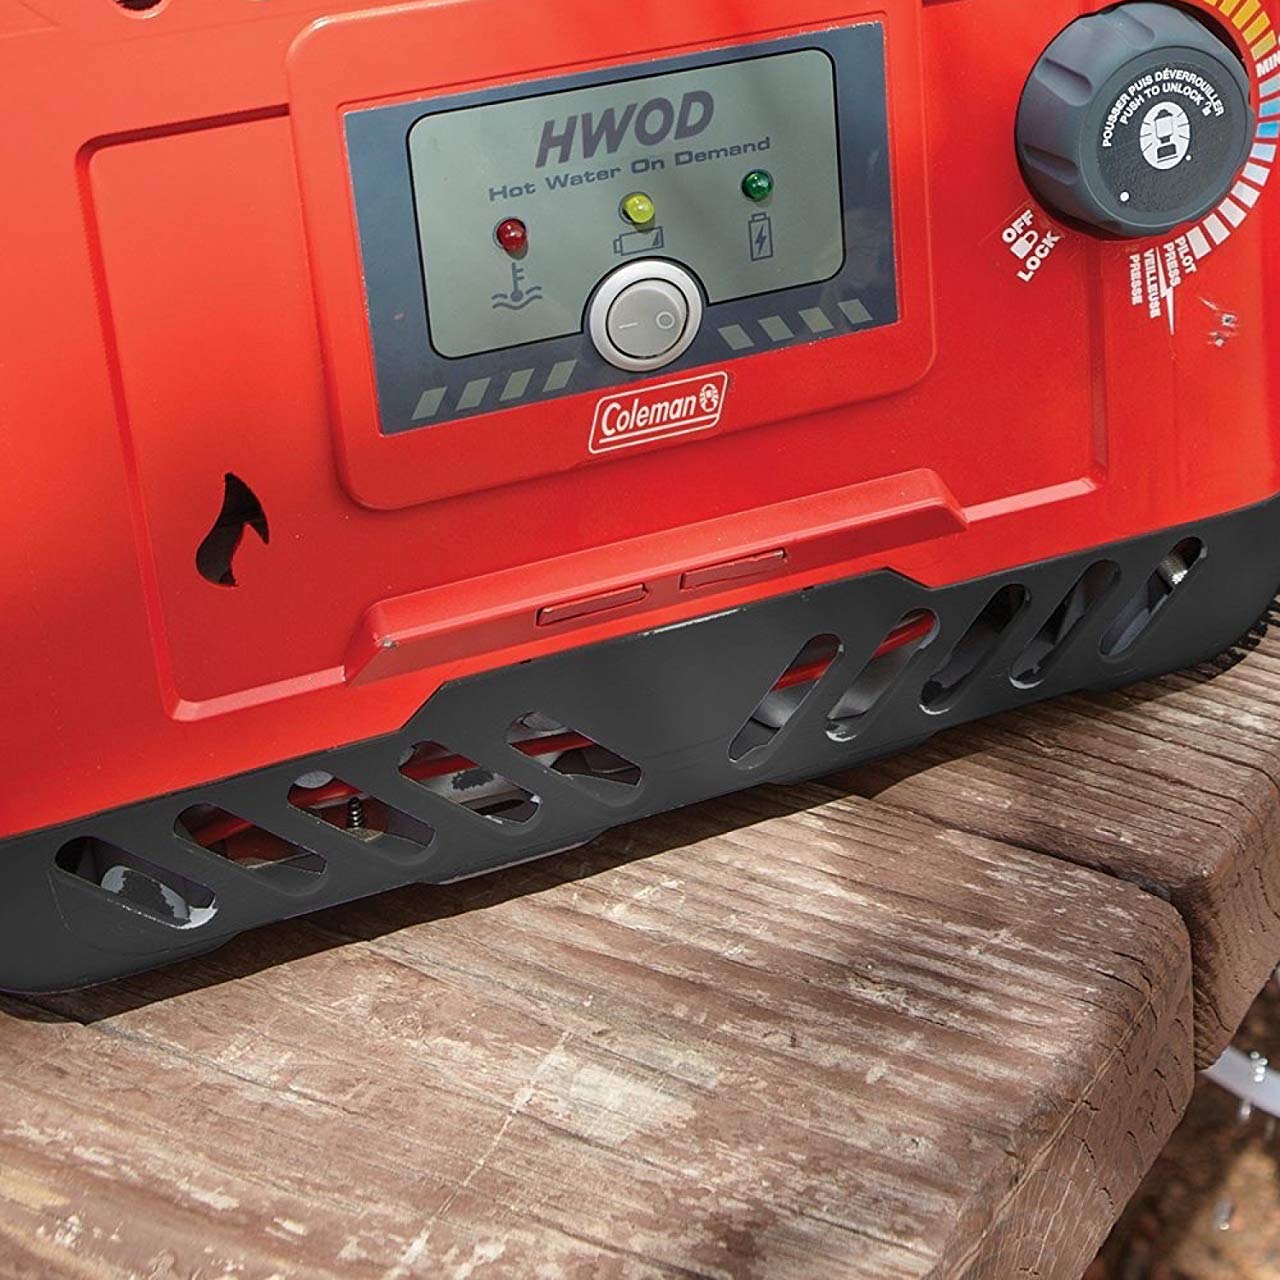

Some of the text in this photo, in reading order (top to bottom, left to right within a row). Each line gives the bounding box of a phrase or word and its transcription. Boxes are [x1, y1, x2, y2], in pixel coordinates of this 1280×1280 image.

[535, 90, 714, 168] HWOD
[1102, 68, 1225, 147] POUSSER PUIS DÉVERROUILLER
[1120, 83, 1204, 124] PUSH TO UNLOCK
[488, 137, 771, 202] Hot Water On Demand
[1002, 209, 1034, 243] OFF
[1016, 230, 1061, 282] LOCK
[1129, 253, 1143, 306] PRESSE
[1163, 242, 1181, 287] PRESS
[1175, 235, 1197, 274] PILOT
[1143, 248, 1161, 318] VEILLEUSE
[601, 393, 698, 436] Coleman
